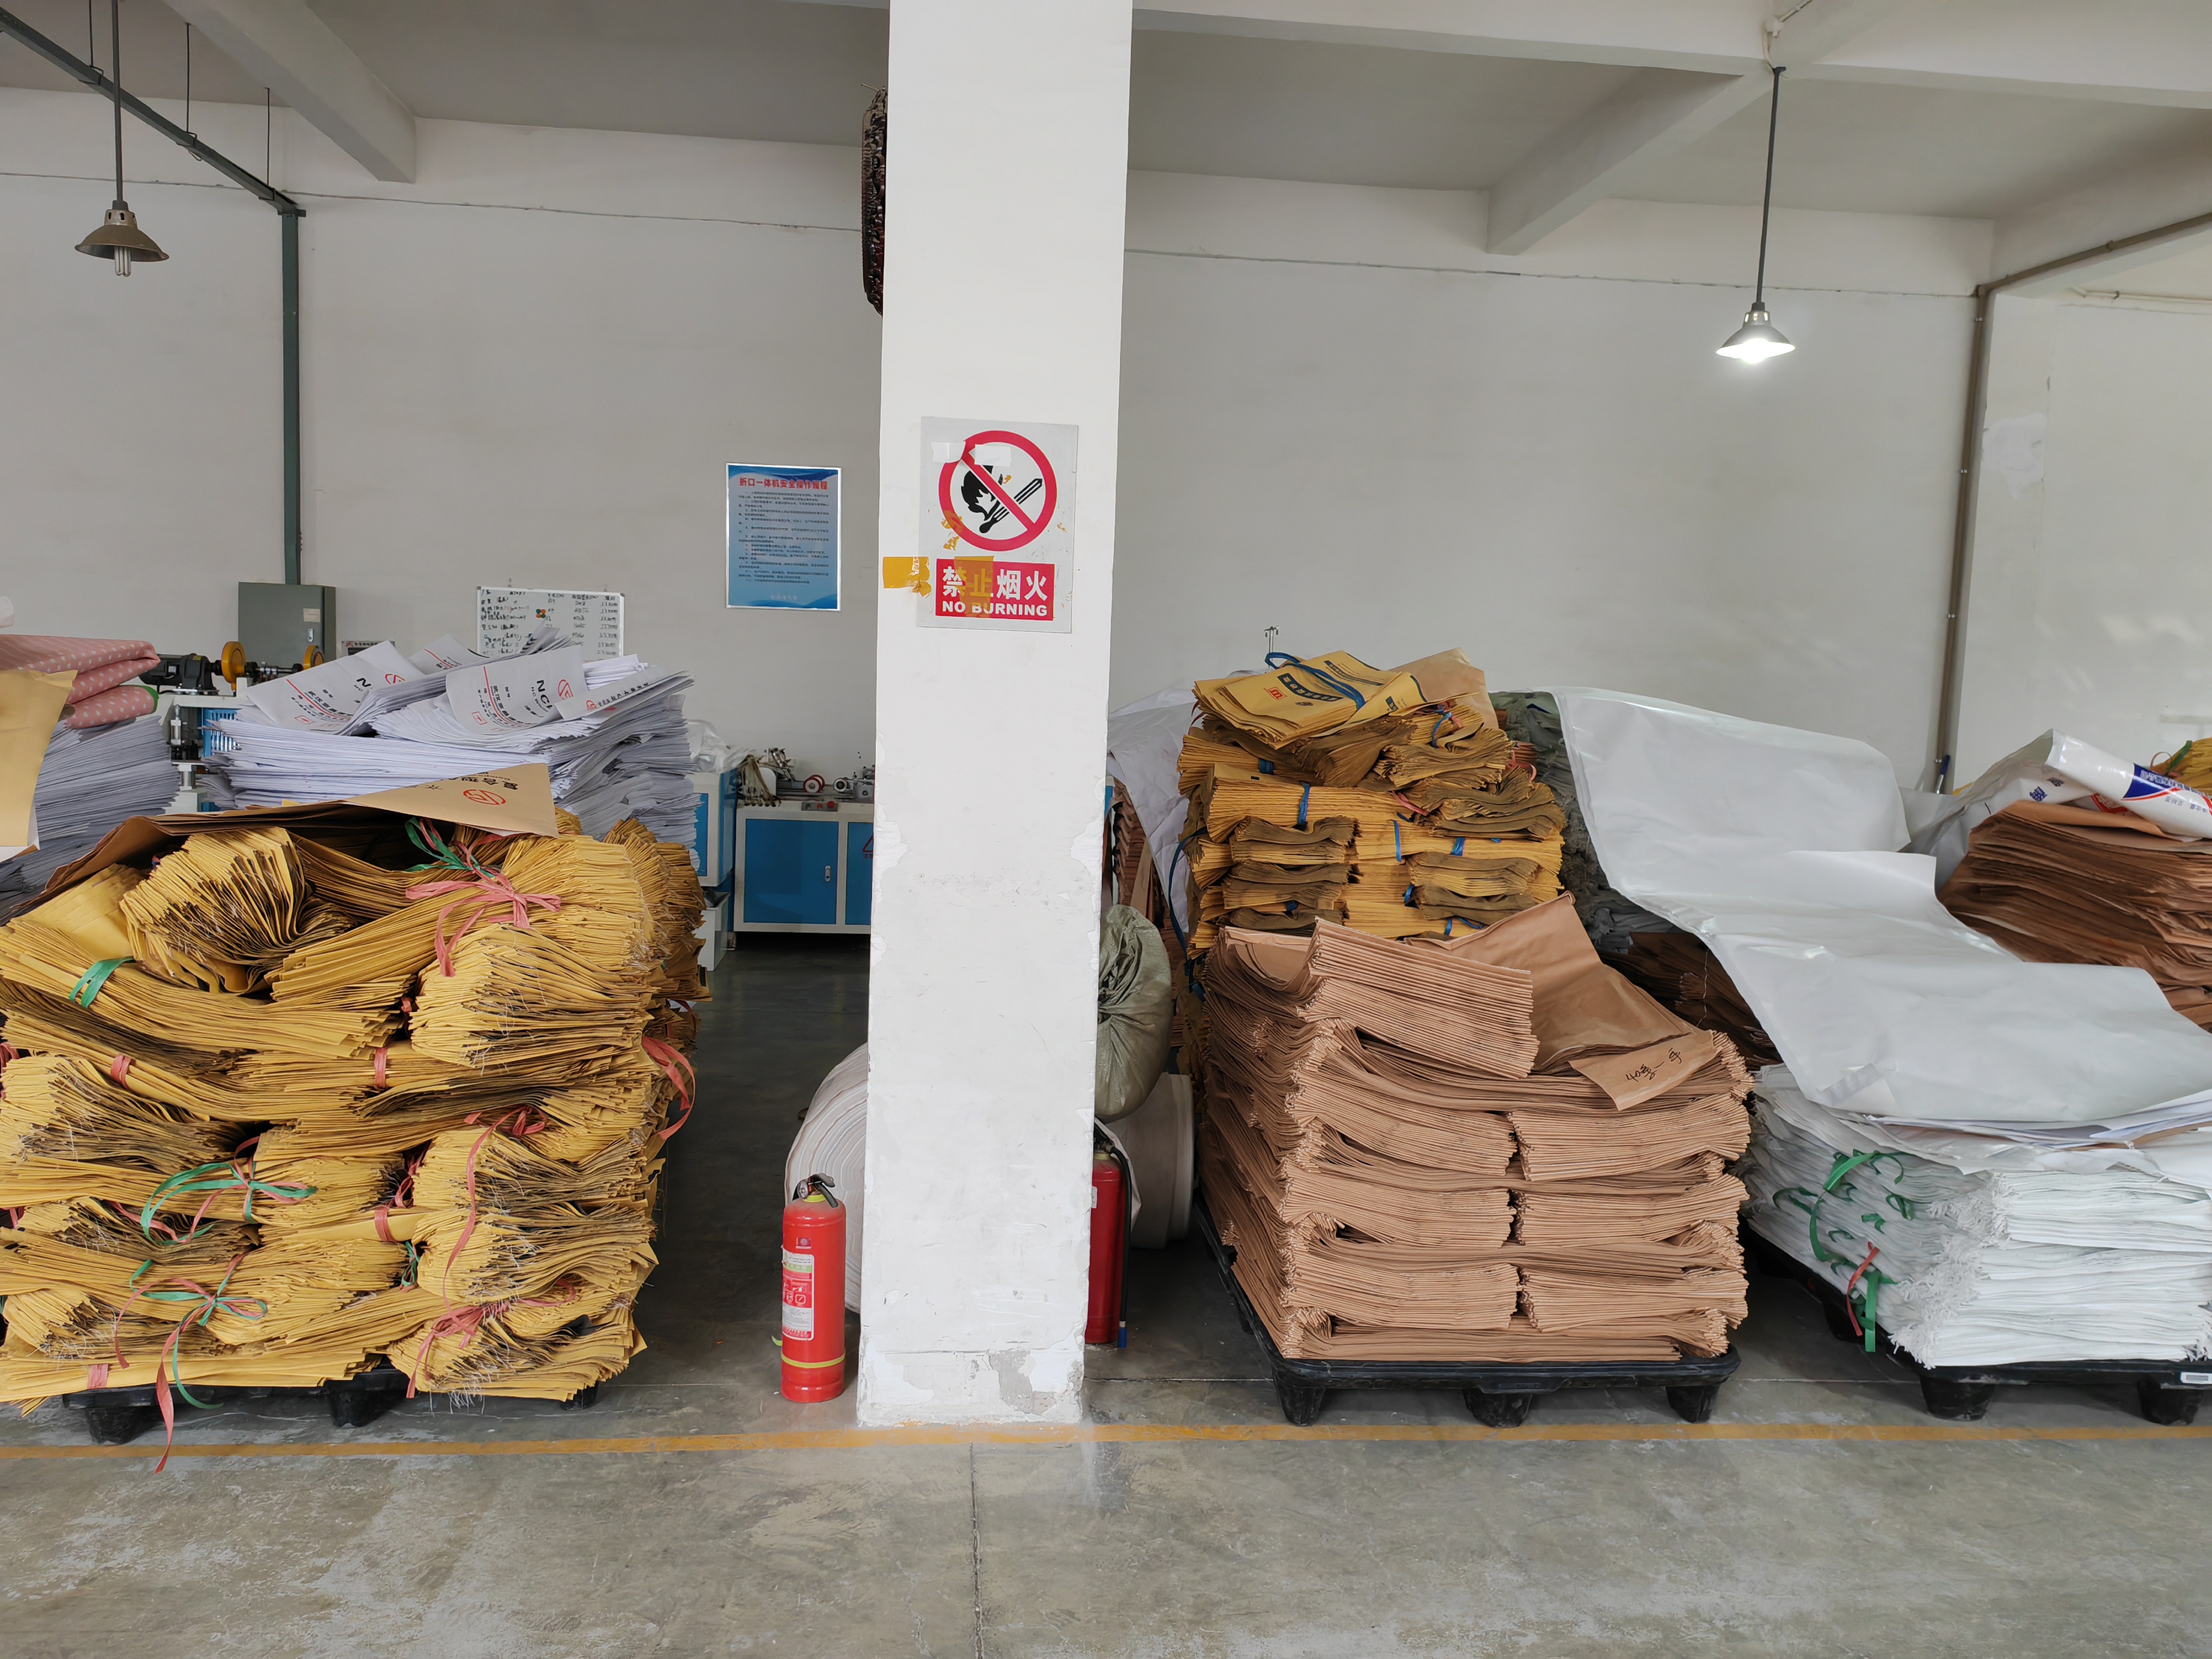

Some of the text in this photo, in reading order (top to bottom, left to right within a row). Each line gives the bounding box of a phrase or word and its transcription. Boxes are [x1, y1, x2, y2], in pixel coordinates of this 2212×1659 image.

[942, 567, 1048, 601] 禁止烟火
[942, 600, 1048, 617] NO BURNING
